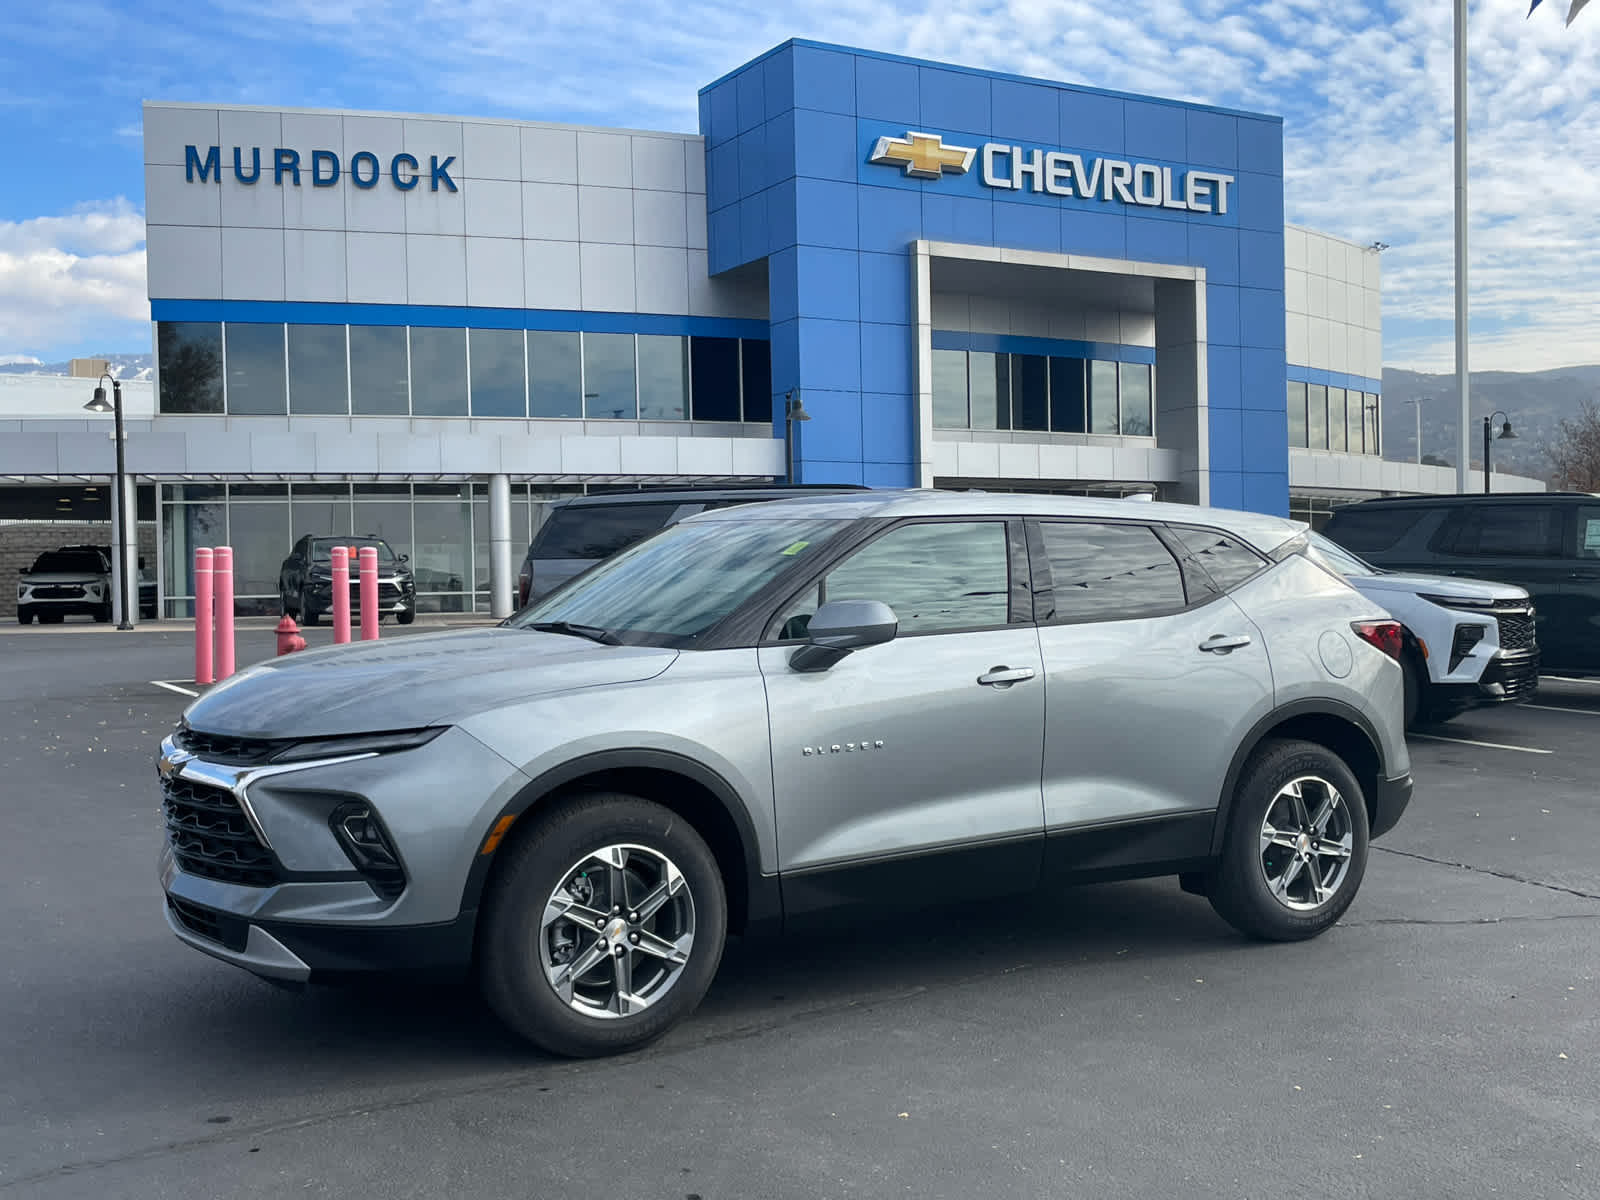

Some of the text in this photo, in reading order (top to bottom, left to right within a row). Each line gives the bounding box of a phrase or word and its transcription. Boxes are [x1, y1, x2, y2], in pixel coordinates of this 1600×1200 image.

[184, 145, 458, 192] MURDOCK
[983, 142, 1234, 214] CHEVROLET
[802, 740, 884, 756] BLAZER
